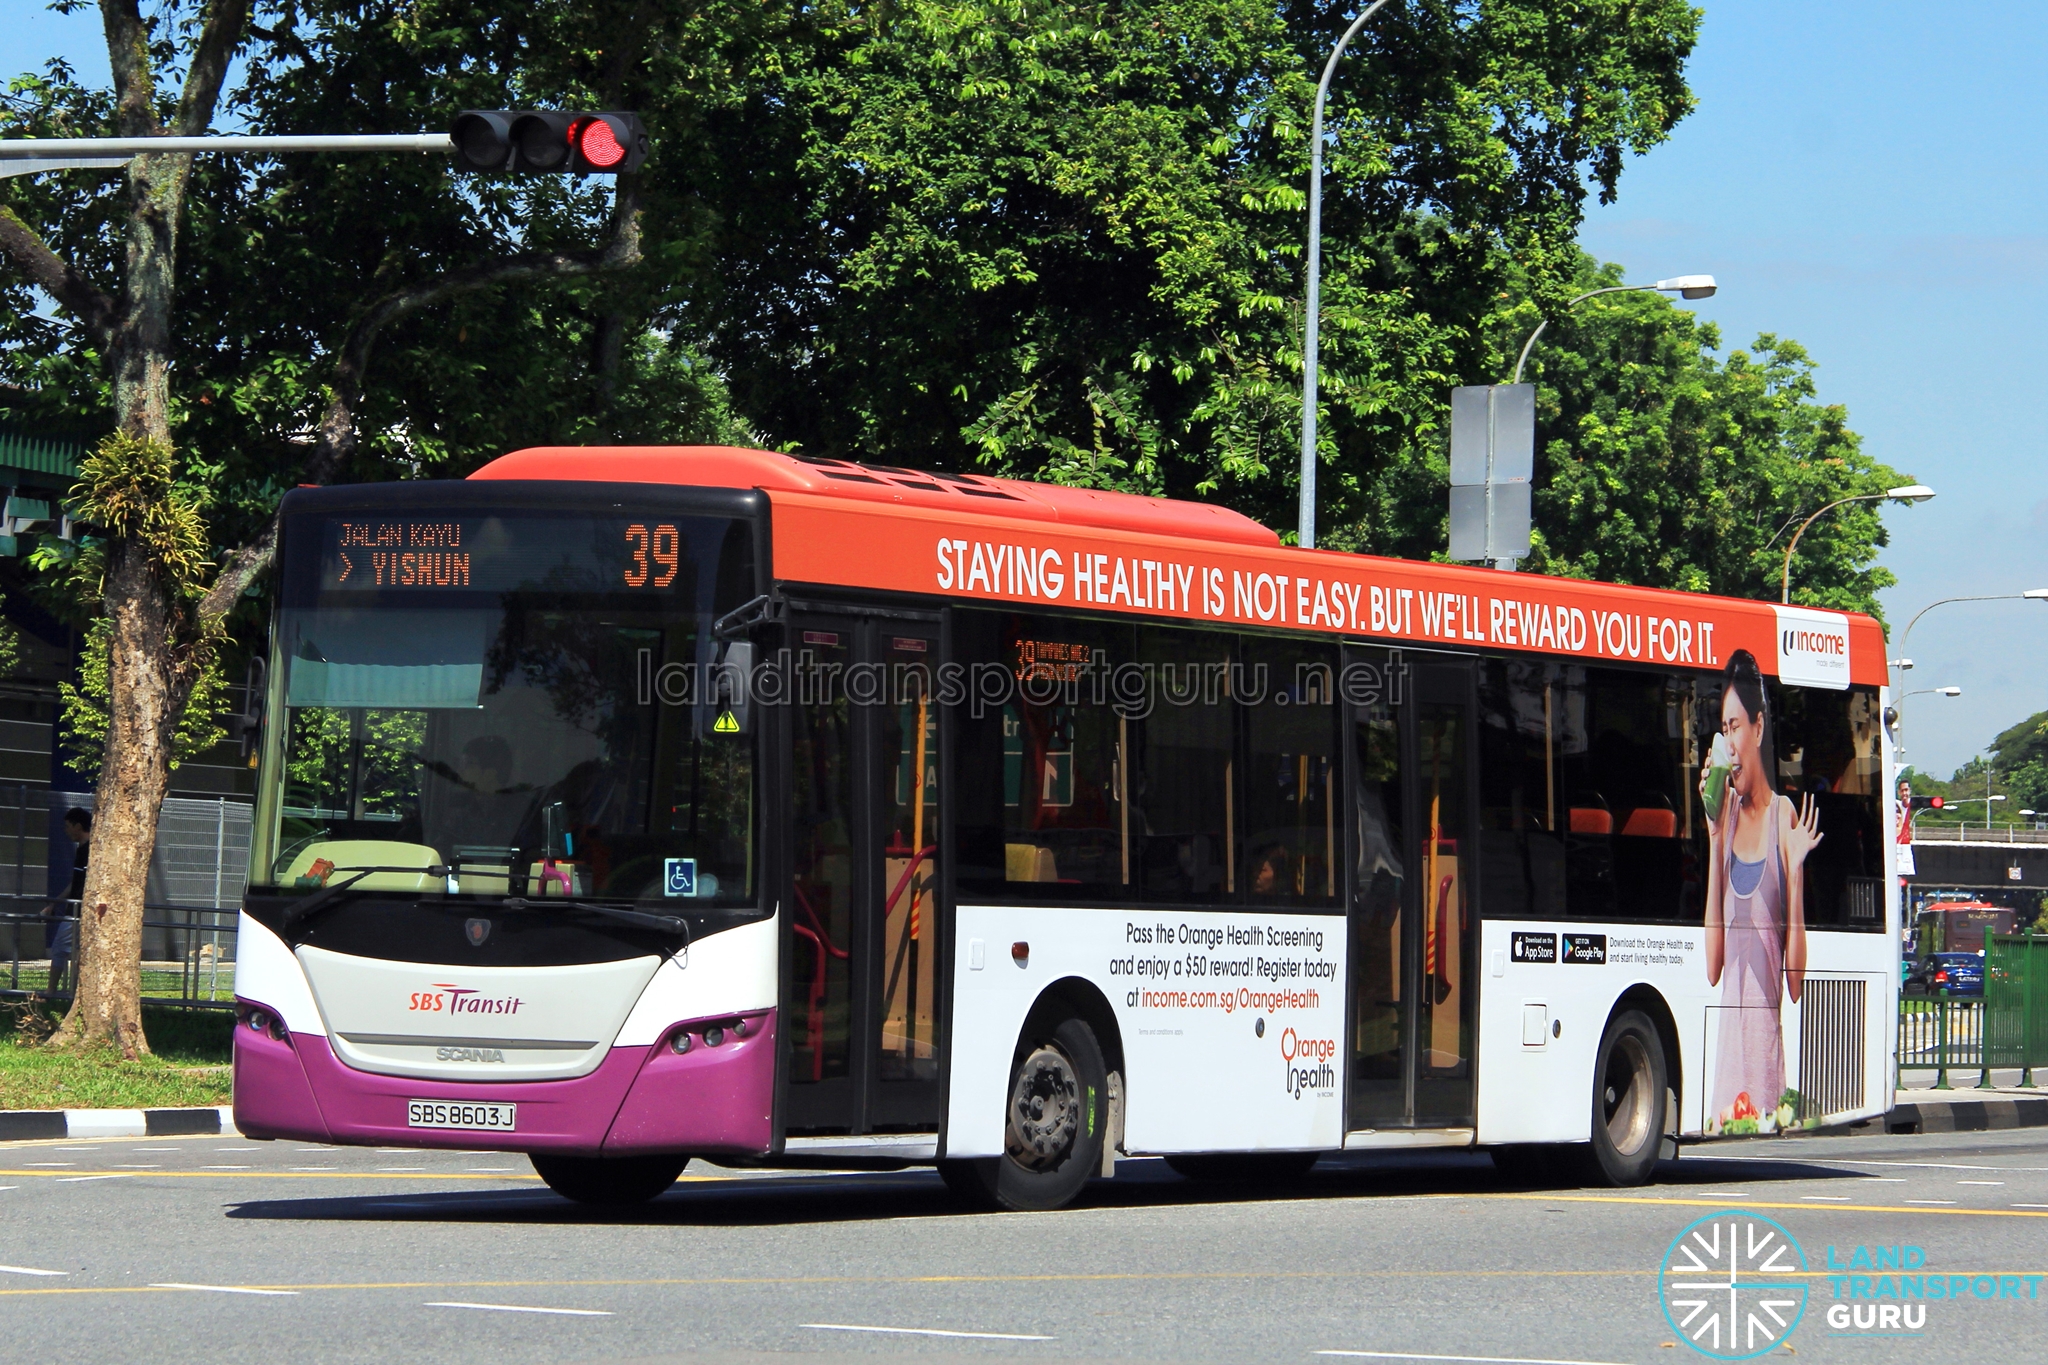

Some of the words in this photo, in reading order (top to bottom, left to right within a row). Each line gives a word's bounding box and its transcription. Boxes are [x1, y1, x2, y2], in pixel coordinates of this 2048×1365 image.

[339, 523, 402, 547] JALAN
[410, 523, 461, 547] KAYU
[624, 523, 680, 588] 39
[372, 552, 470, 586] YISHUN
[936, 537, 1064, 600] STAYING
[1073, 551, 1195, 613] HEALTHY
[1202, 566, 1224, 618] IS
[1233, 569, 1289, 623] NOT
[1371, 586, 1413, 635] BUT
[1419, 590, 1485, 642] WE'LL
[1490, 599, 1588, 652] REWARD
[1593, 610, 1642, 659] YOU
[1648, 617, 1693, 663] FOR
[1698, 622, 1717, 666] IT.
[1126, 922, 1153, 944] Pass
[1156, 923, 1175, 944] the
[1178, 924, 1223, 950] Orange
[1226, 925, 1264, 946] Health
[1266, 926, 1323, 952] Screening
[1525, 936, 1542, 944] Download
[1610, 936, 1636, 948] Download
[1637, 939, 1646, 949] the
[1647, 938, 1665, 951] Orange
[1666, 939, 1683, 950] Health
[1684, 941, 1695, 952] app
[1525, 945, 1538, 960] App
[1538, 946, 1553, 958] Store
[1575, 946, 1593, 960] Google
[1593, 947, 1604, 960] Play
[1609, 952, 1620, 963] and
[1621, 953, 1633, 963] start
[1634, 953, 1648, 966] living
[1649, 953, 1668, 966] healthy
[1109, 955, 1134, 976] and
[1137, 955, 1171, 980] enjoy
[1173, 961, 1182, 976] a
[1185, 953, 1207, 979] $50
[1209, 957, 1253, 977] reward!
[1256, 957, 1301, 983] Register
[1304, 958, 1337, 982] today
[409, 992, 444, 1012] SBS
[442, 989, 527, 1016] Transit
[1126, 987, 1139, 1008] at
[1142, 987, 1320, 1014] income.com.sg/OrangeHealth
[436, 1047, 505, 1064] SCANIA
[1281, 1027, 1335, 1063] Orange
[410, 1104, 514, 1127] SBS8603J
